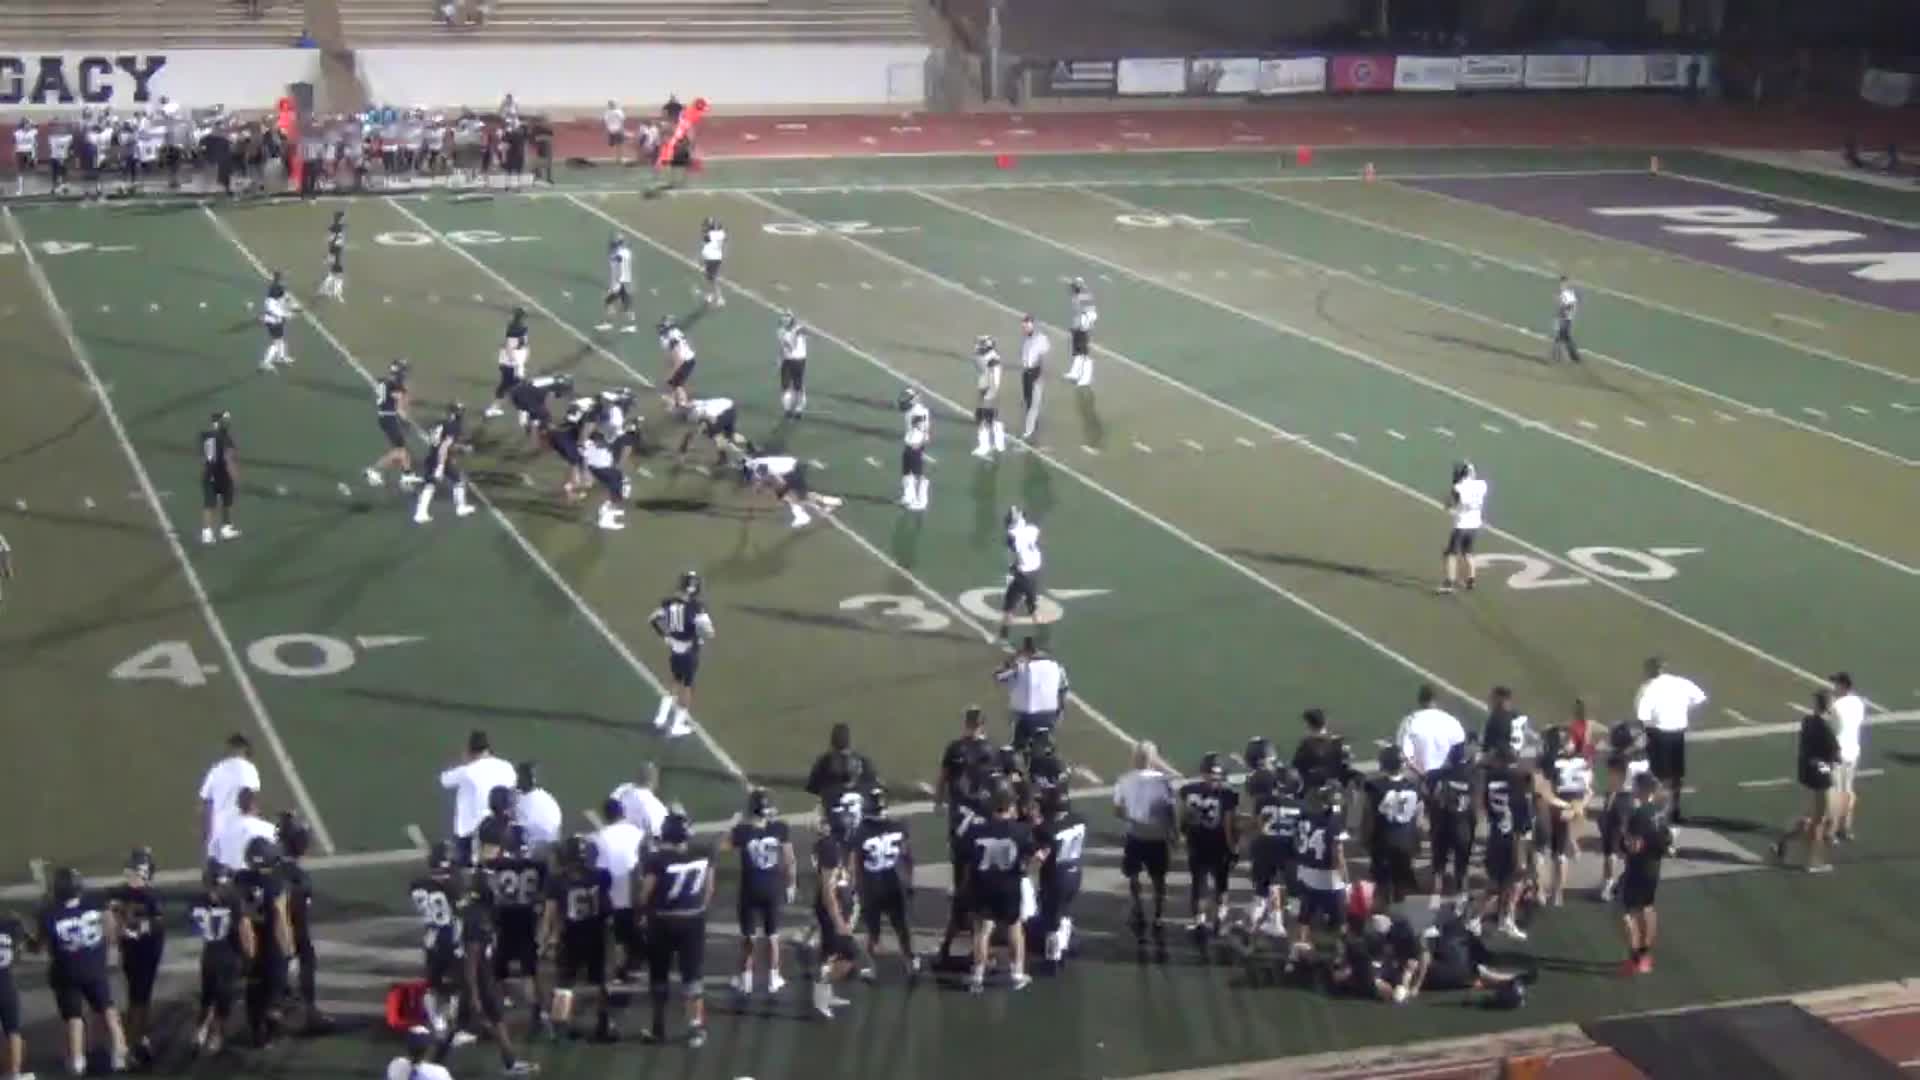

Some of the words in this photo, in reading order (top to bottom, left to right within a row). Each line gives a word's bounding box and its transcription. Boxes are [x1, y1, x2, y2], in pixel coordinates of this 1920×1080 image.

[0, 56, 167, 104] GACY
[1471, 546, 1679, 590] 20
[840, 583, 1064, 632] 30
[108, 632, 355, 687] 40
[862, 831, 903, 872] 35
[665, 858, 709, 899] 77
